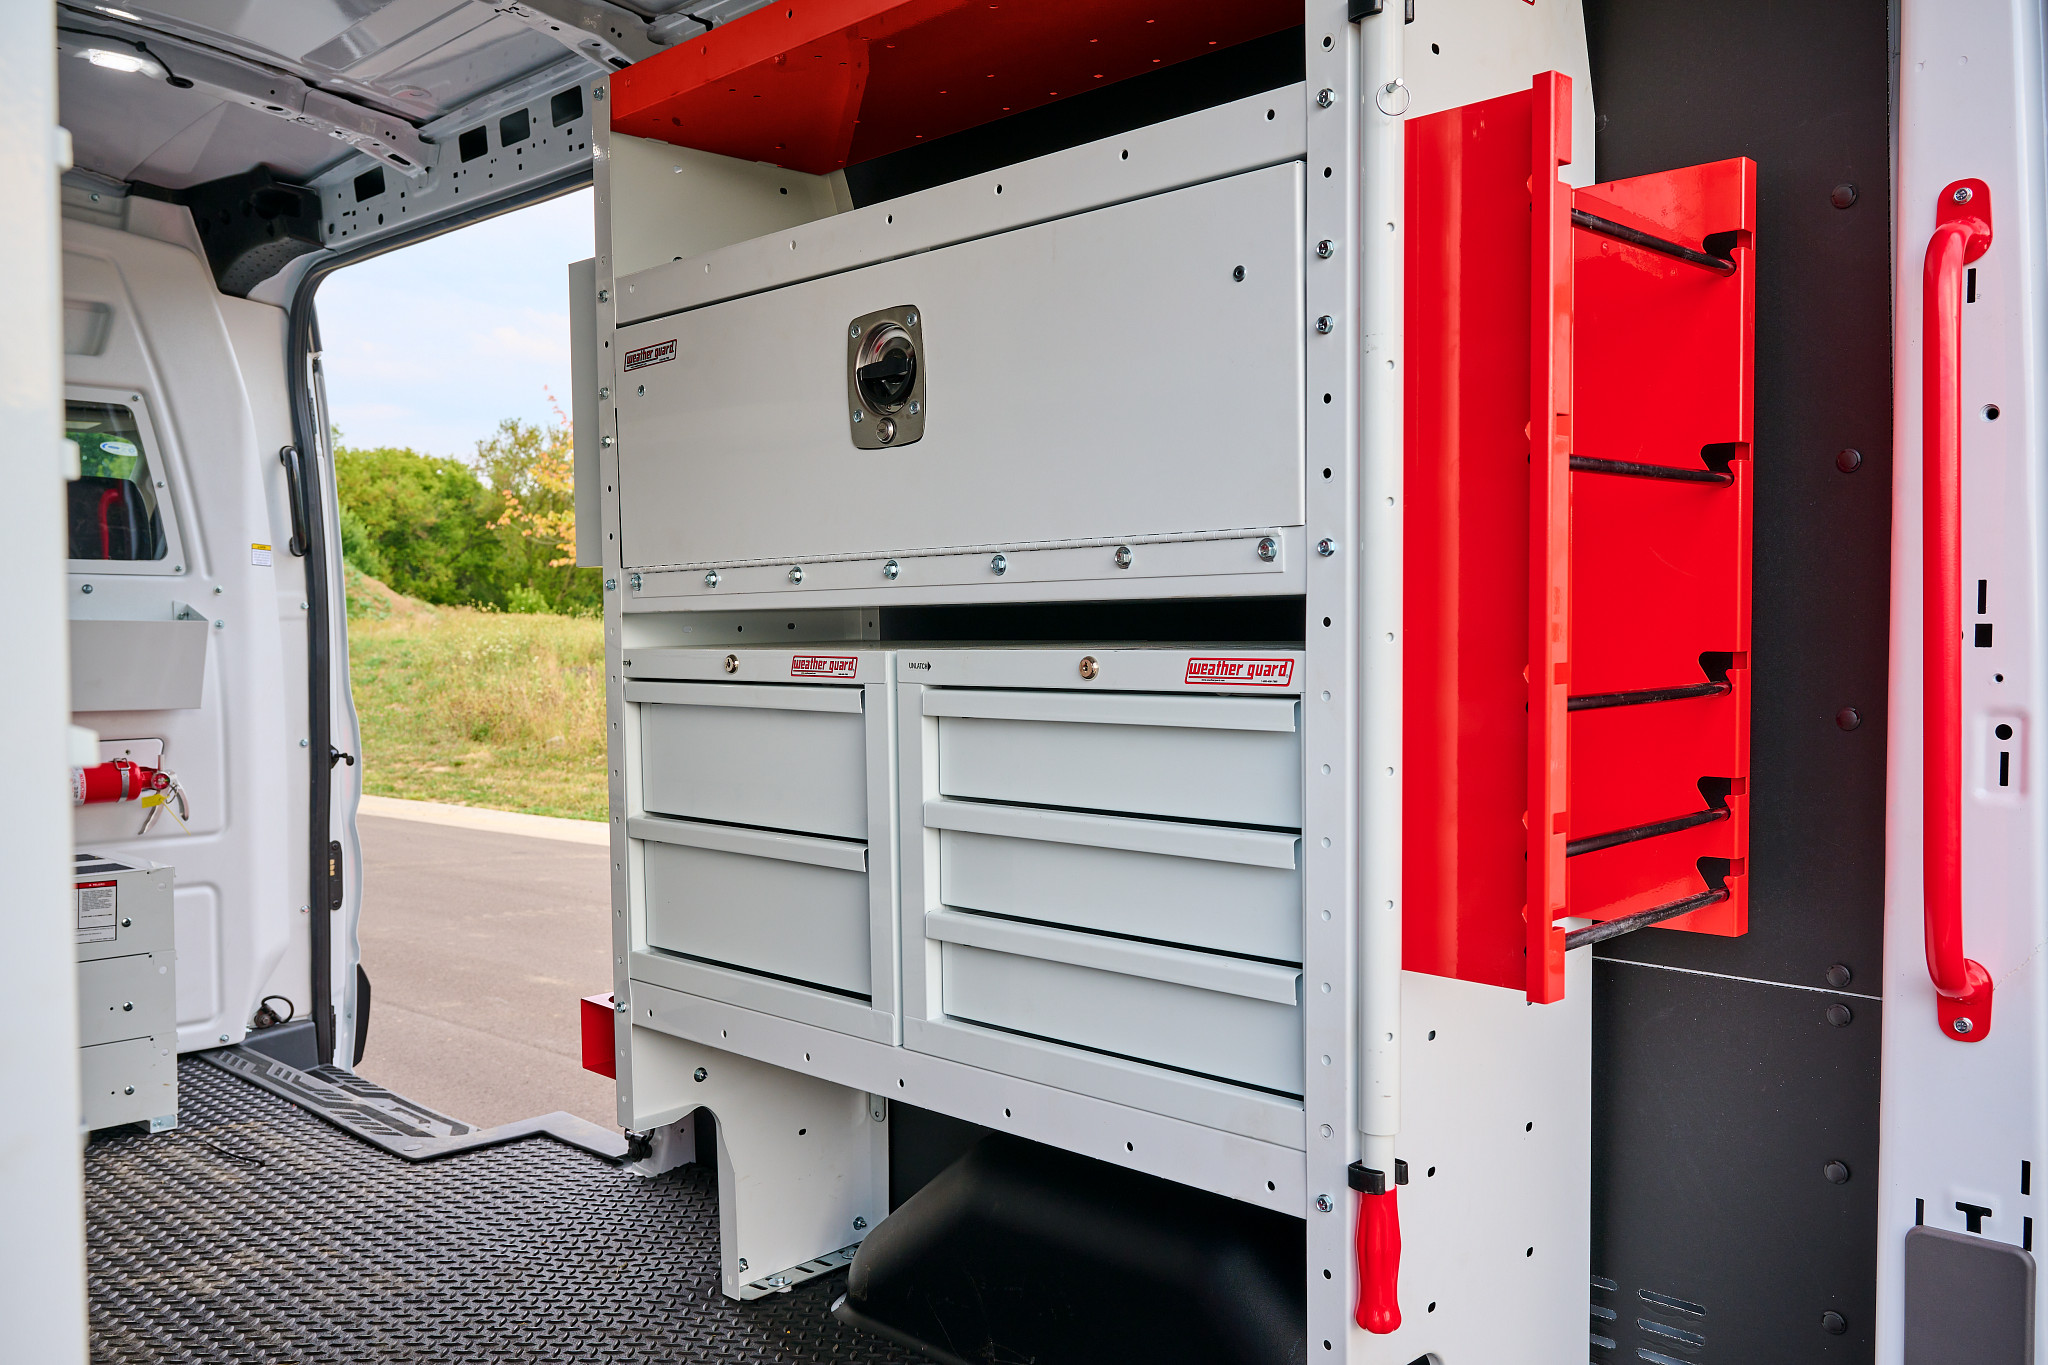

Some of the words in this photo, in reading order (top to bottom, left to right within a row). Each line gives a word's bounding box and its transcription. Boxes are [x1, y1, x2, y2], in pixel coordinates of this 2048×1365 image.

[626, 350, 653, 364] weather
[654, 341, 674, 360] guard
[793, 657, 827, 670] weather
[829, 658, 854, 673] guard
[1189, 660, 1243, 676] weather
[1247, 661, 1288, 680] guard
